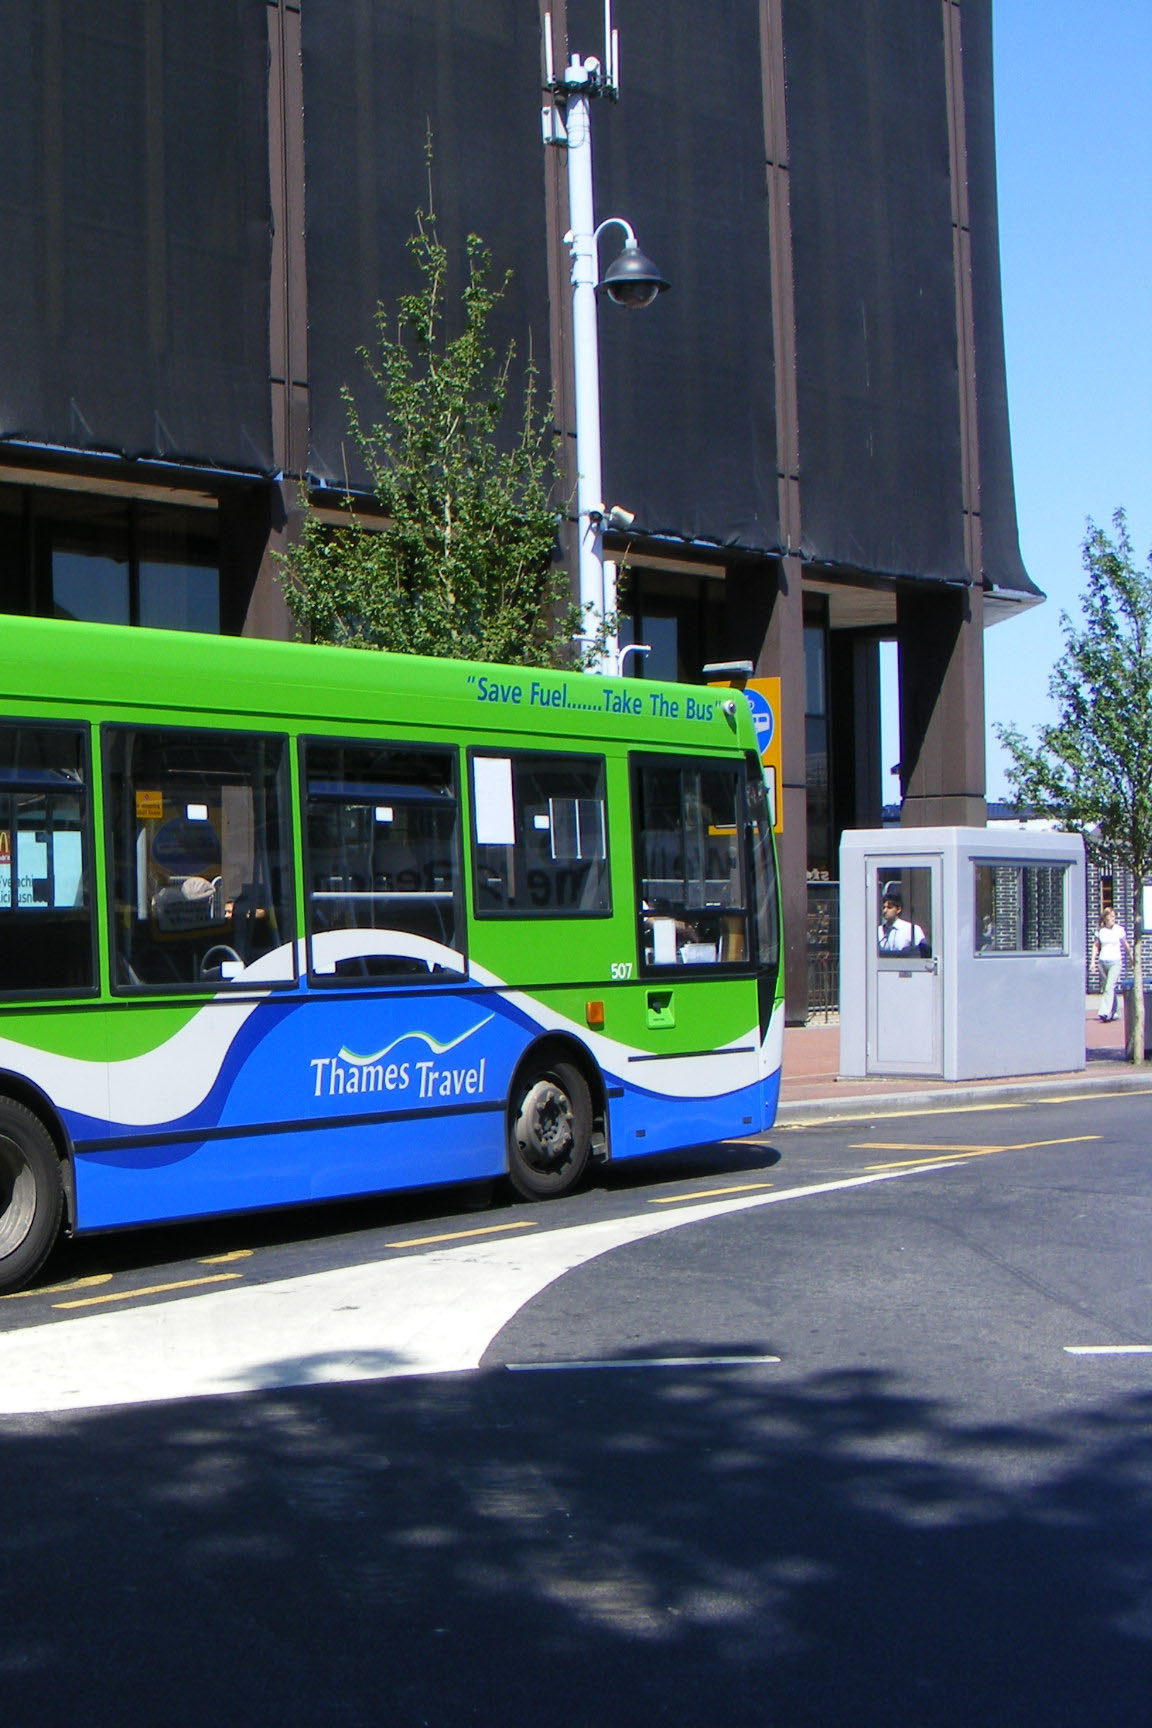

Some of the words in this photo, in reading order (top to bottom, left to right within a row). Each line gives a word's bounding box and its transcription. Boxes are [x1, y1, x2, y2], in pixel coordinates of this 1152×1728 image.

[650, 693, 679, 719] The
[610, 963, 633, 980] 507
[310, 1057, 410, 1096] Thames
[415, 1057, 486, 1098] Travel
